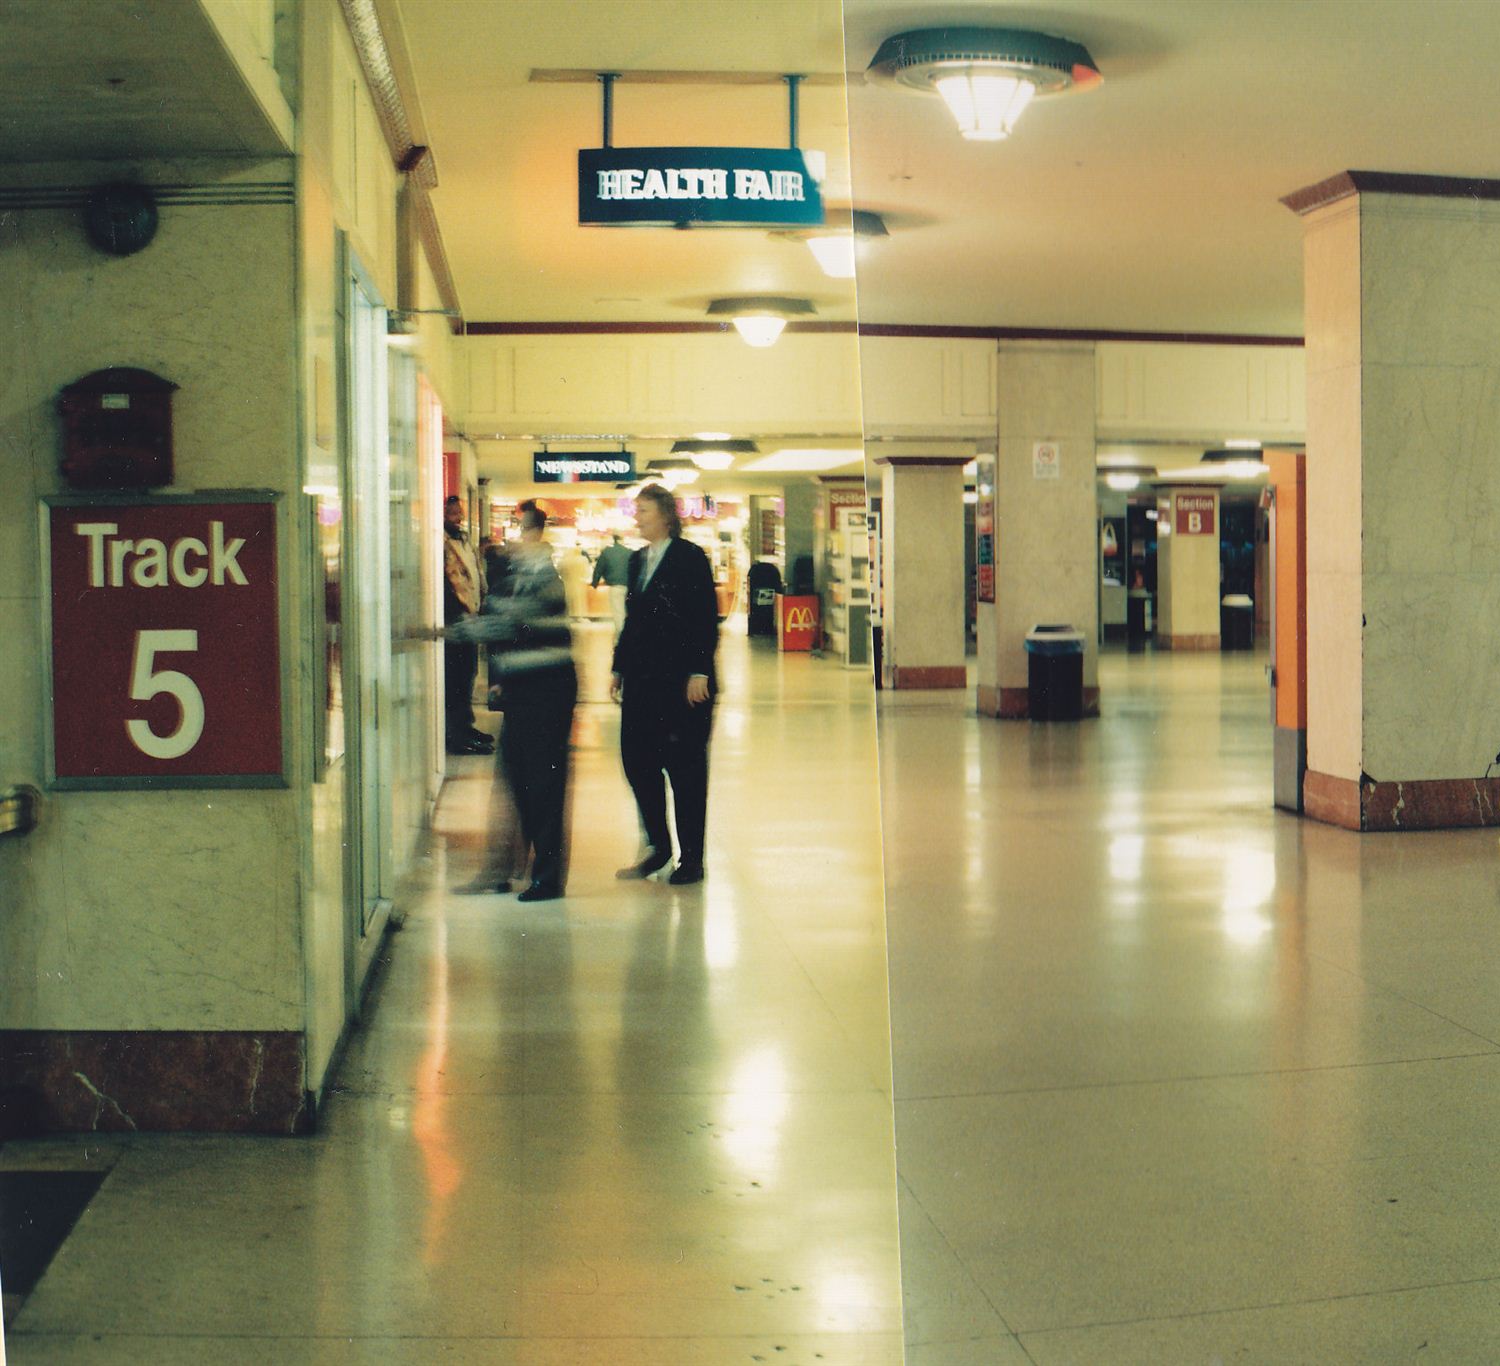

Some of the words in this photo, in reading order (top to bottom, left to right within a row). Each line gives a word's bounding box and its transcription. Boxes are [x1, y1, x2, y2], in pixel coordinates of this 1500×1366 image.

[596, 168, 729, 200] HEALTH
[733, 168, 806, 201] FAIR
[1177, 496, 1214, 511] Section
[1188, 511, 1202, 534] B
[74, 520, 250, 588] Track
[124, 629, 205, 760] 5
